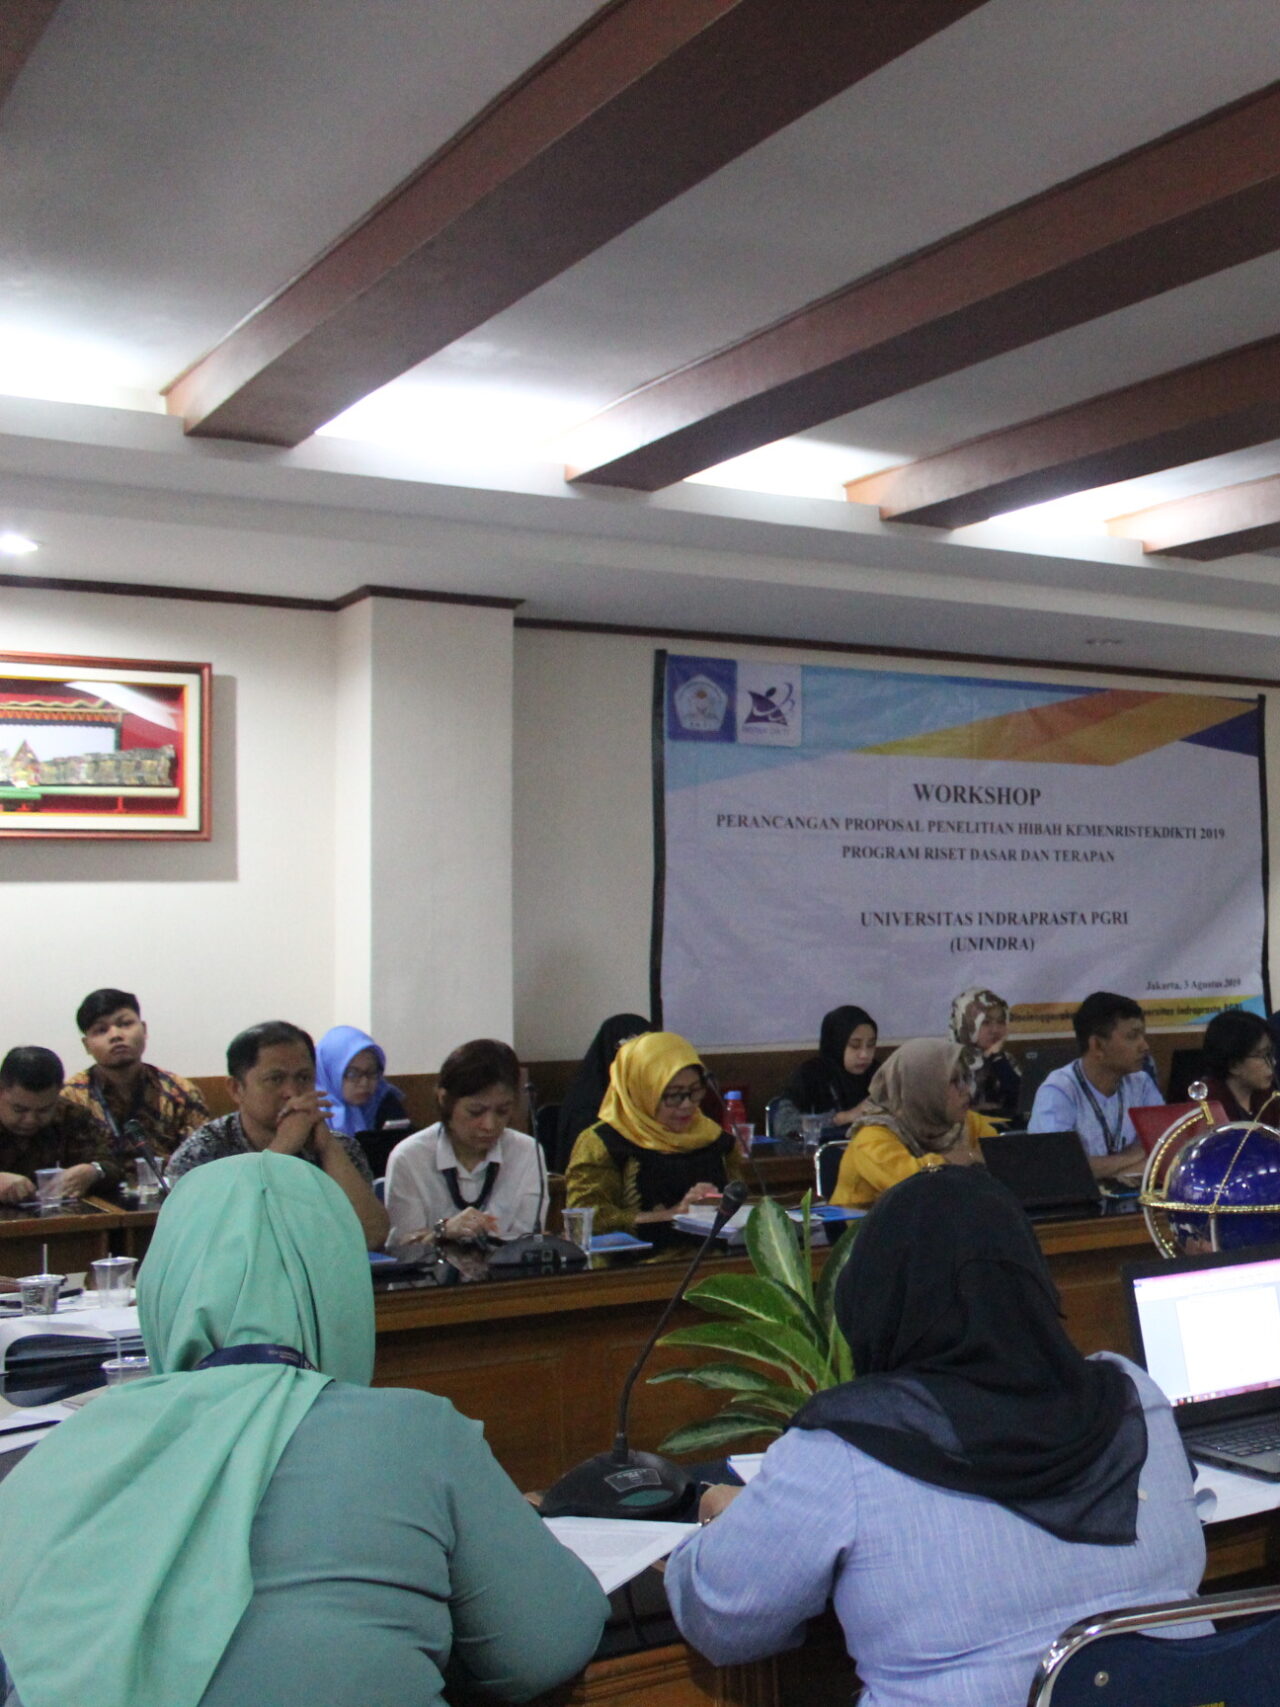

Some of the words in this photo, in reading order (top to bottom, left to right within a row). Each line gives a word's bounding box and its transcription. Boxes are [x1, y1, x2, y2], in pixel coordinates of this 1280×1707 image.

[913, 783, 1042, 806] WORKSHOP
[716, 813, 840, 830] PERANCANGAN
[844, 817, 924, 832] PROPOSAL
[927, 820, 1014, 835] PENELITIAN
[1018, 822, 1062, 836] HIBAH
[1066, 824, 1197, 839] KEMENRISTEKDIKTI
[1200, 827, 1225, 840] 2019
[842, 845, 921, 860] PROGRAM
[924, 847, 965, 861] RISET
[970, 849, 1017, 862] DASAR
[1020, 850, 1050, 862] DAN
[1054, 850, 1116, 863] TERAPAN
[860, 911, 973, 927] UNIVERSITAS
[978, 911, 1087, 926] INDRAPRASTA
[1091, 911, 1129, 925] PGRI
[950, 936, 1036, 953] (UNINDRA)
